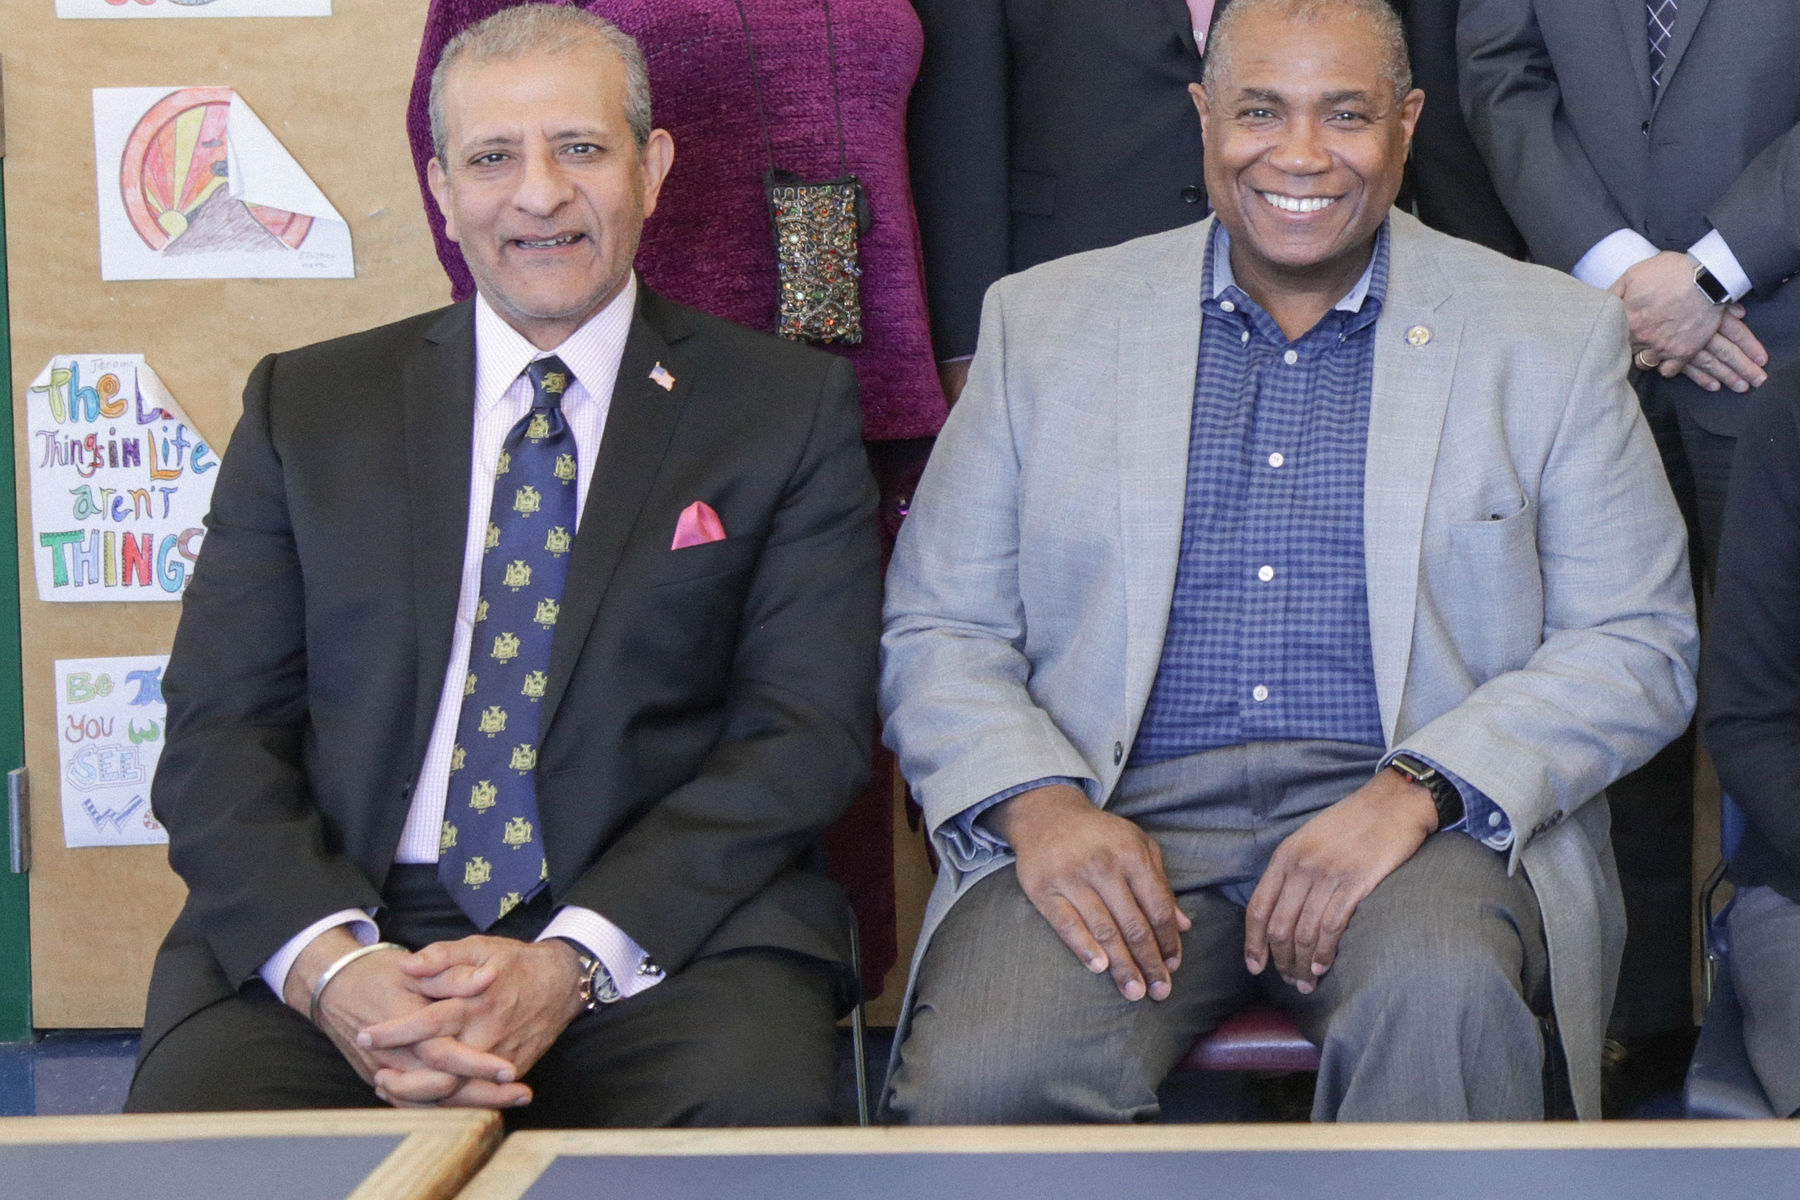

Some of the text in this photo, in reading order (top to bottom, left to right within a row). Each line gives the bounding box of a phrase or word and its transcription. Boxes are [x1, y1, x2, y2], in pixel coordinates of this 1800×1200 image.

[31, 360, 128, 425] The
[148, 423, 217, 481] Life
[66, 671, 115, 704] Be
[70, 750, 138, 786] SEE
